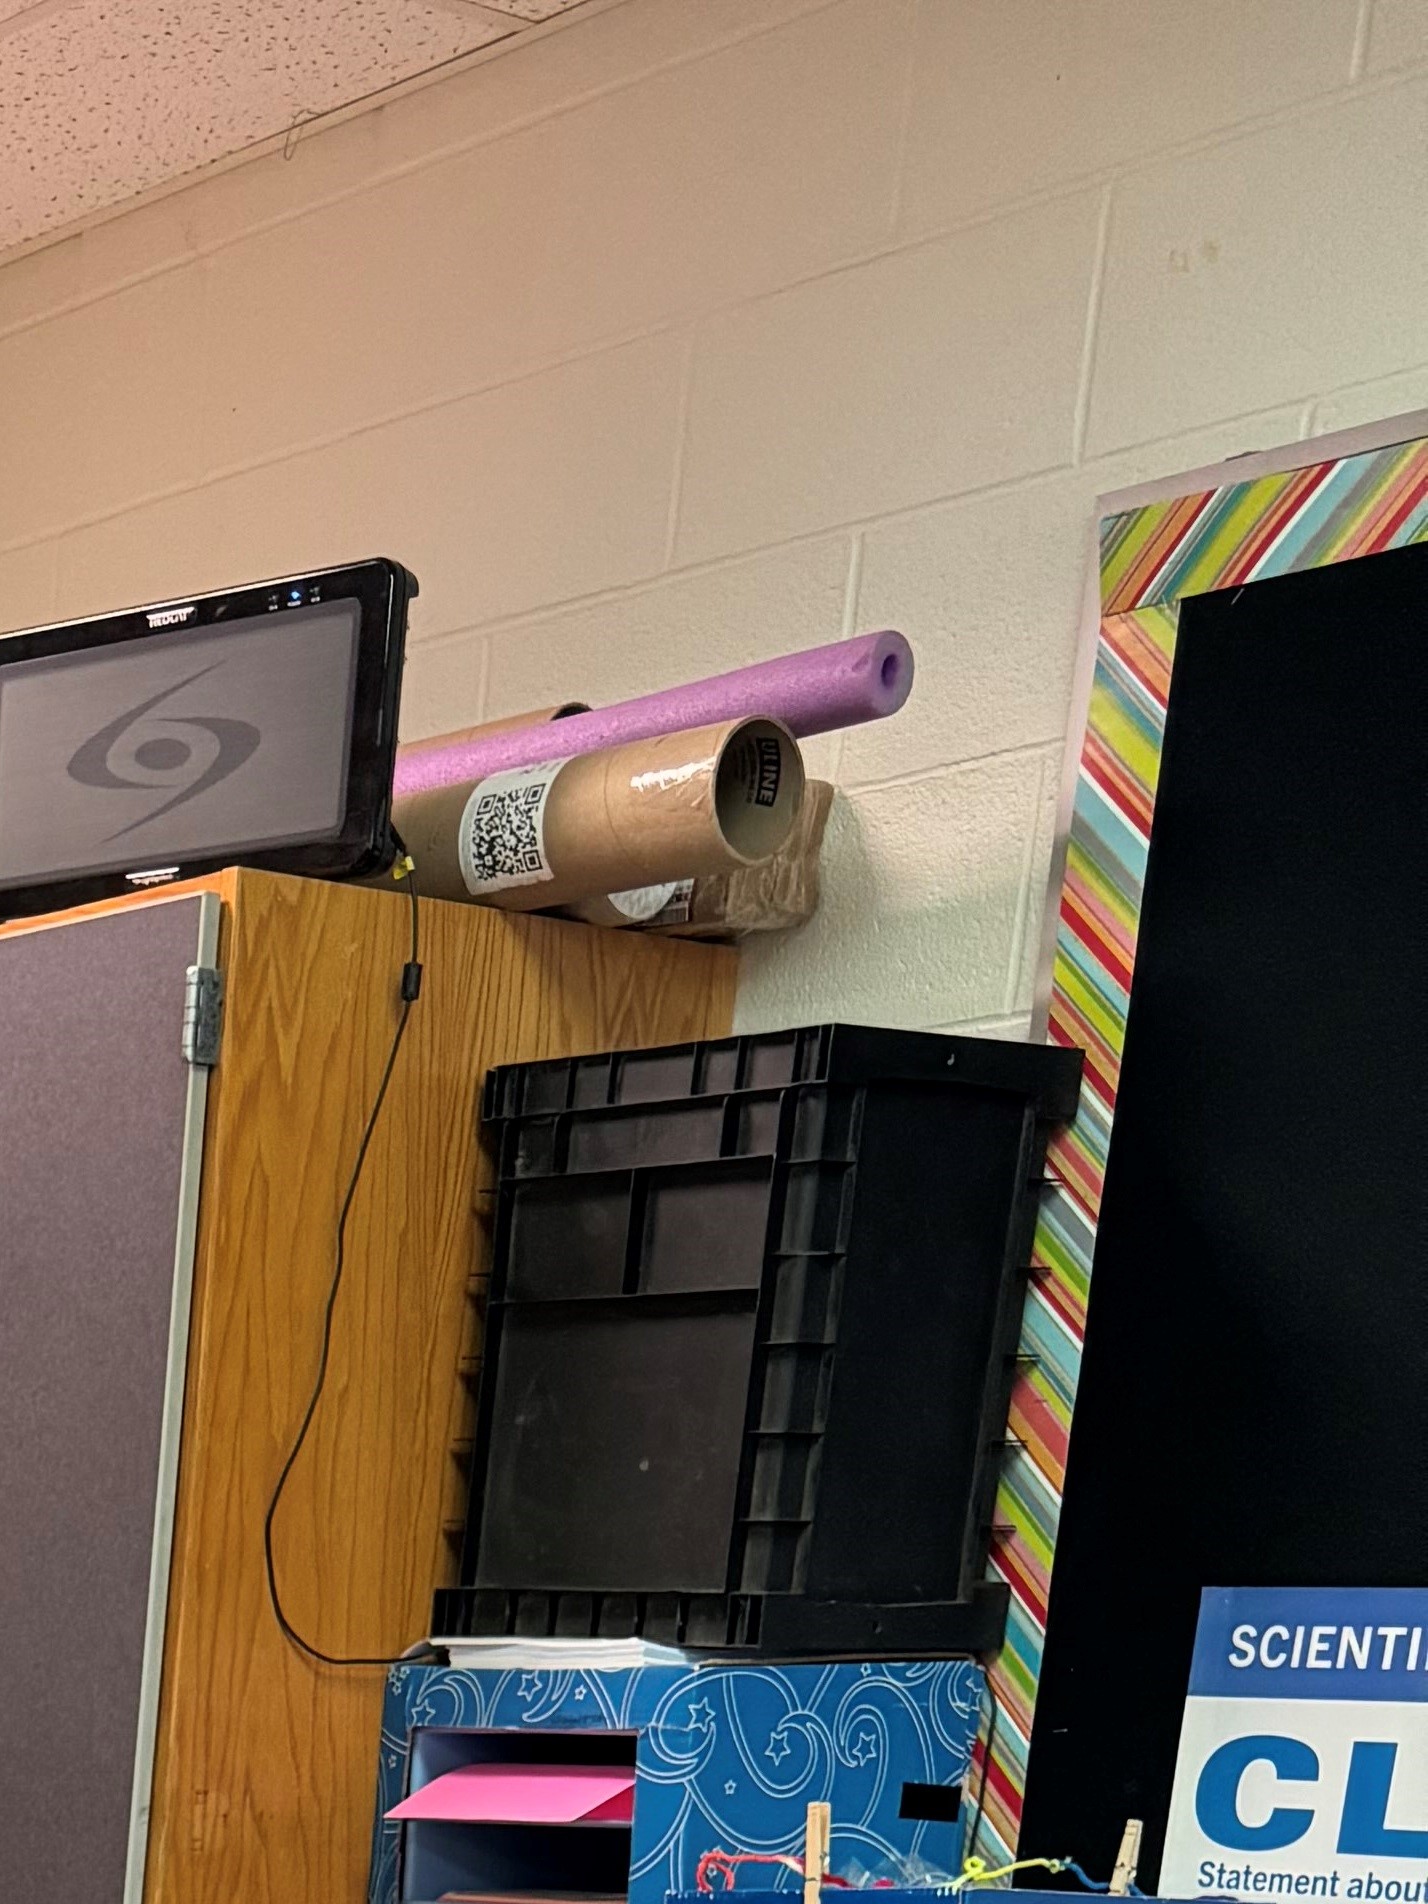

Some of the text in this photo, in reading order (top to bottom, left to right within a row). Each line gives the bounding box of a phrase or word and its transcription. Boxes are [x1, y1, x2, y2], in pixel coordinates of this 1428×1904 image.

[759, 741, 779, 804] ULINE
[1229, 1624, 1428, 1671] SCIENTI
[1198, 1861, 1340, 1897] Statement
